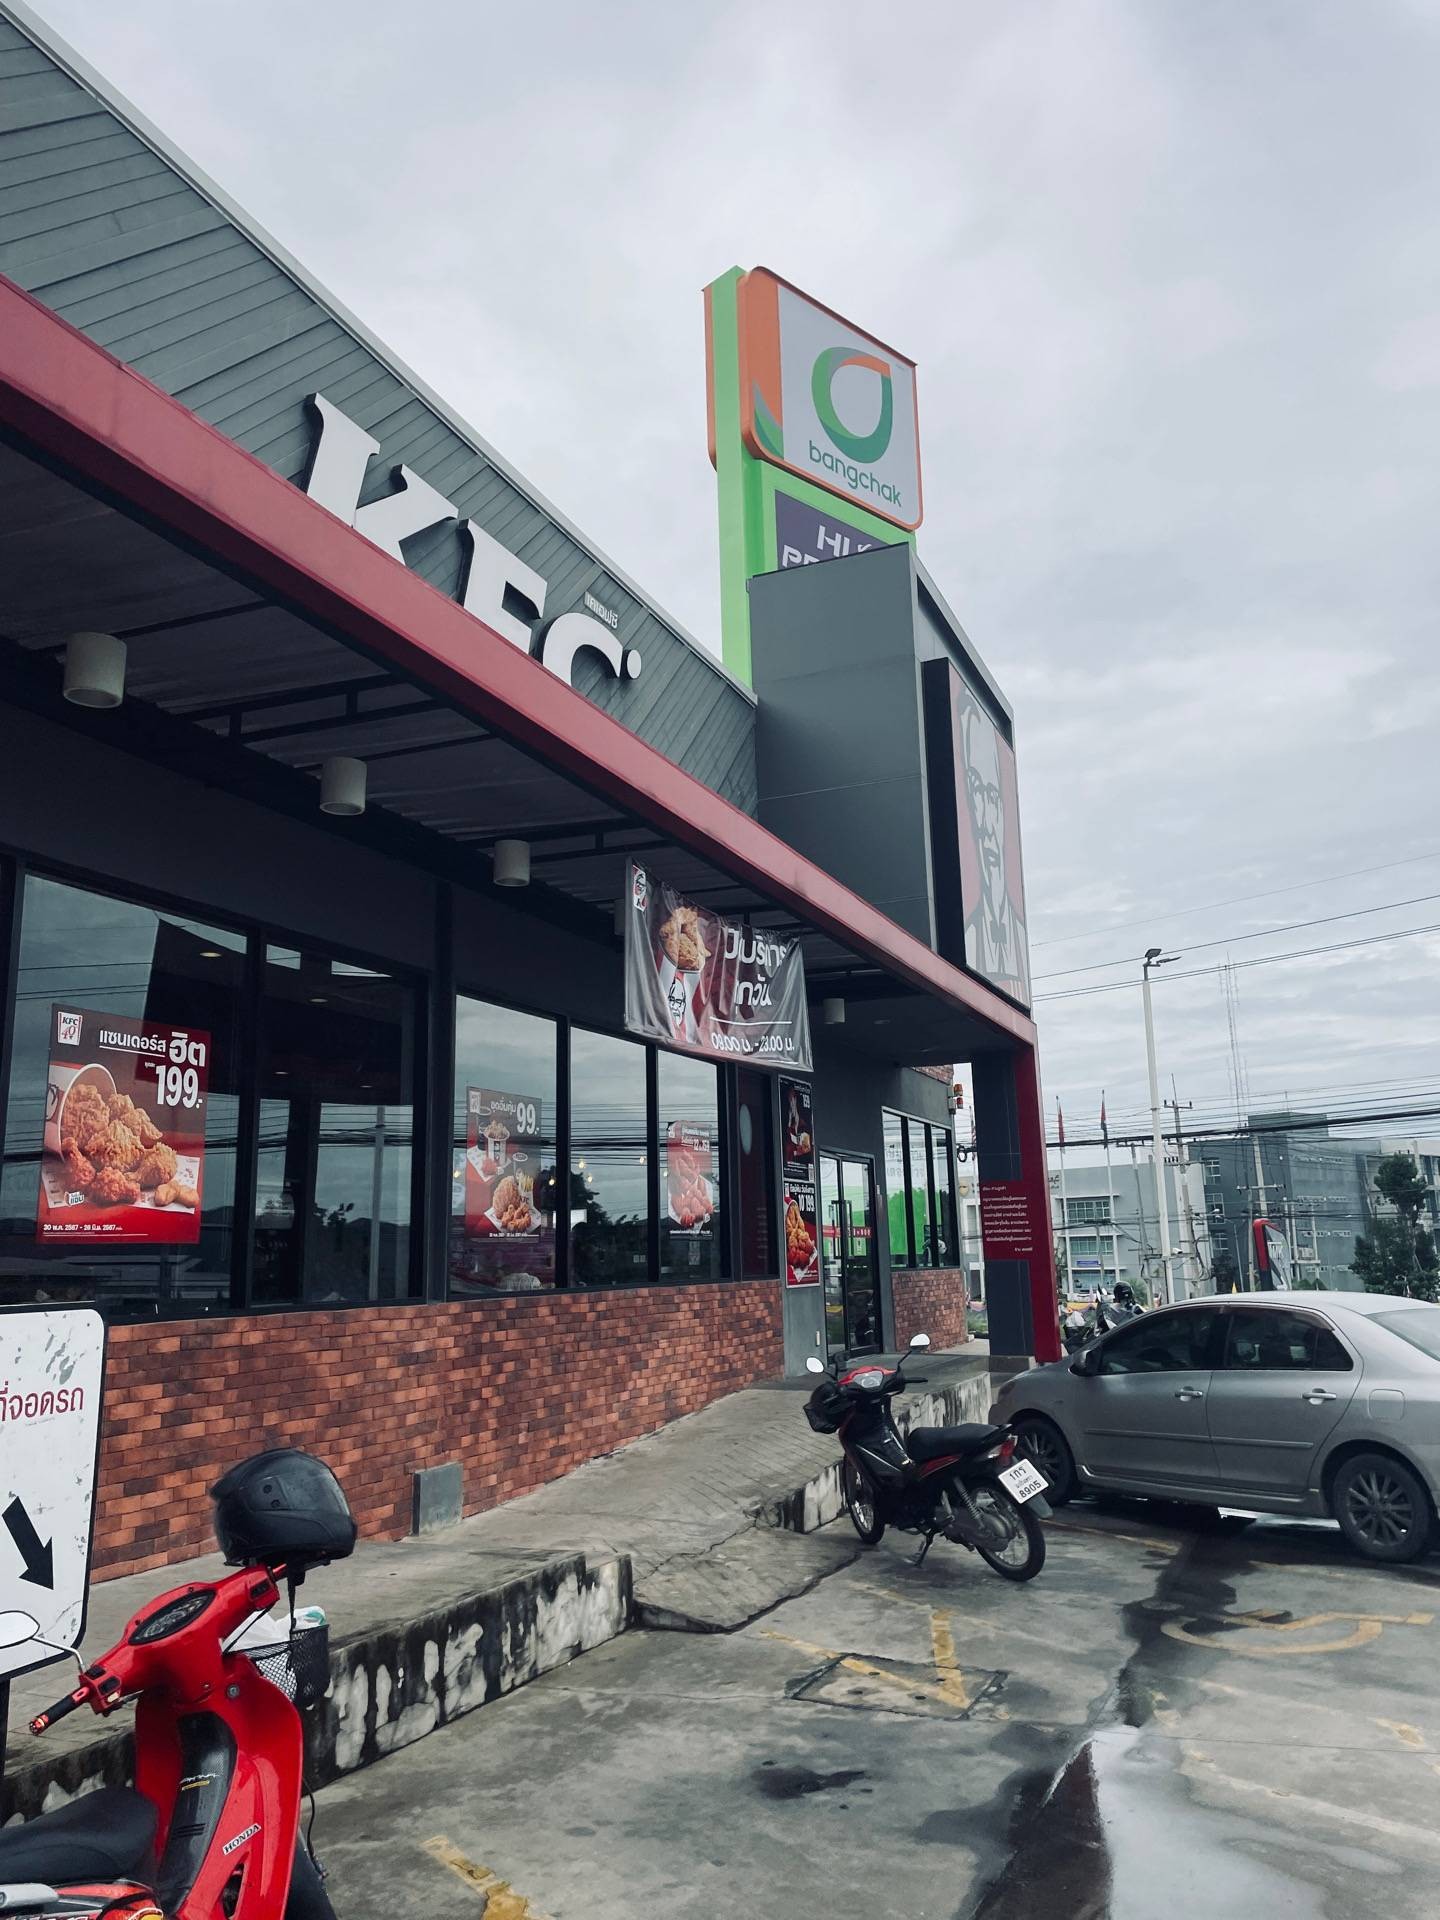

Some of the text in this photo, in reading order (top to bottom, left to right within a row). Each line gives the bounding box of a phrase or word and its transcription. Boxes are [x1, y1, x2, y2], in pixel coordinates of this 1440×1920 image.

[809, 440, 902, 507] bangchak
[62, 1016, 79, 1026] KFC
[99, 1029, 206, 1067] แซนเดอร์ส ฮิต
[1019, 1480, 1042, 1498] 8905
[223, 1824, 261, 1854] HONDA
